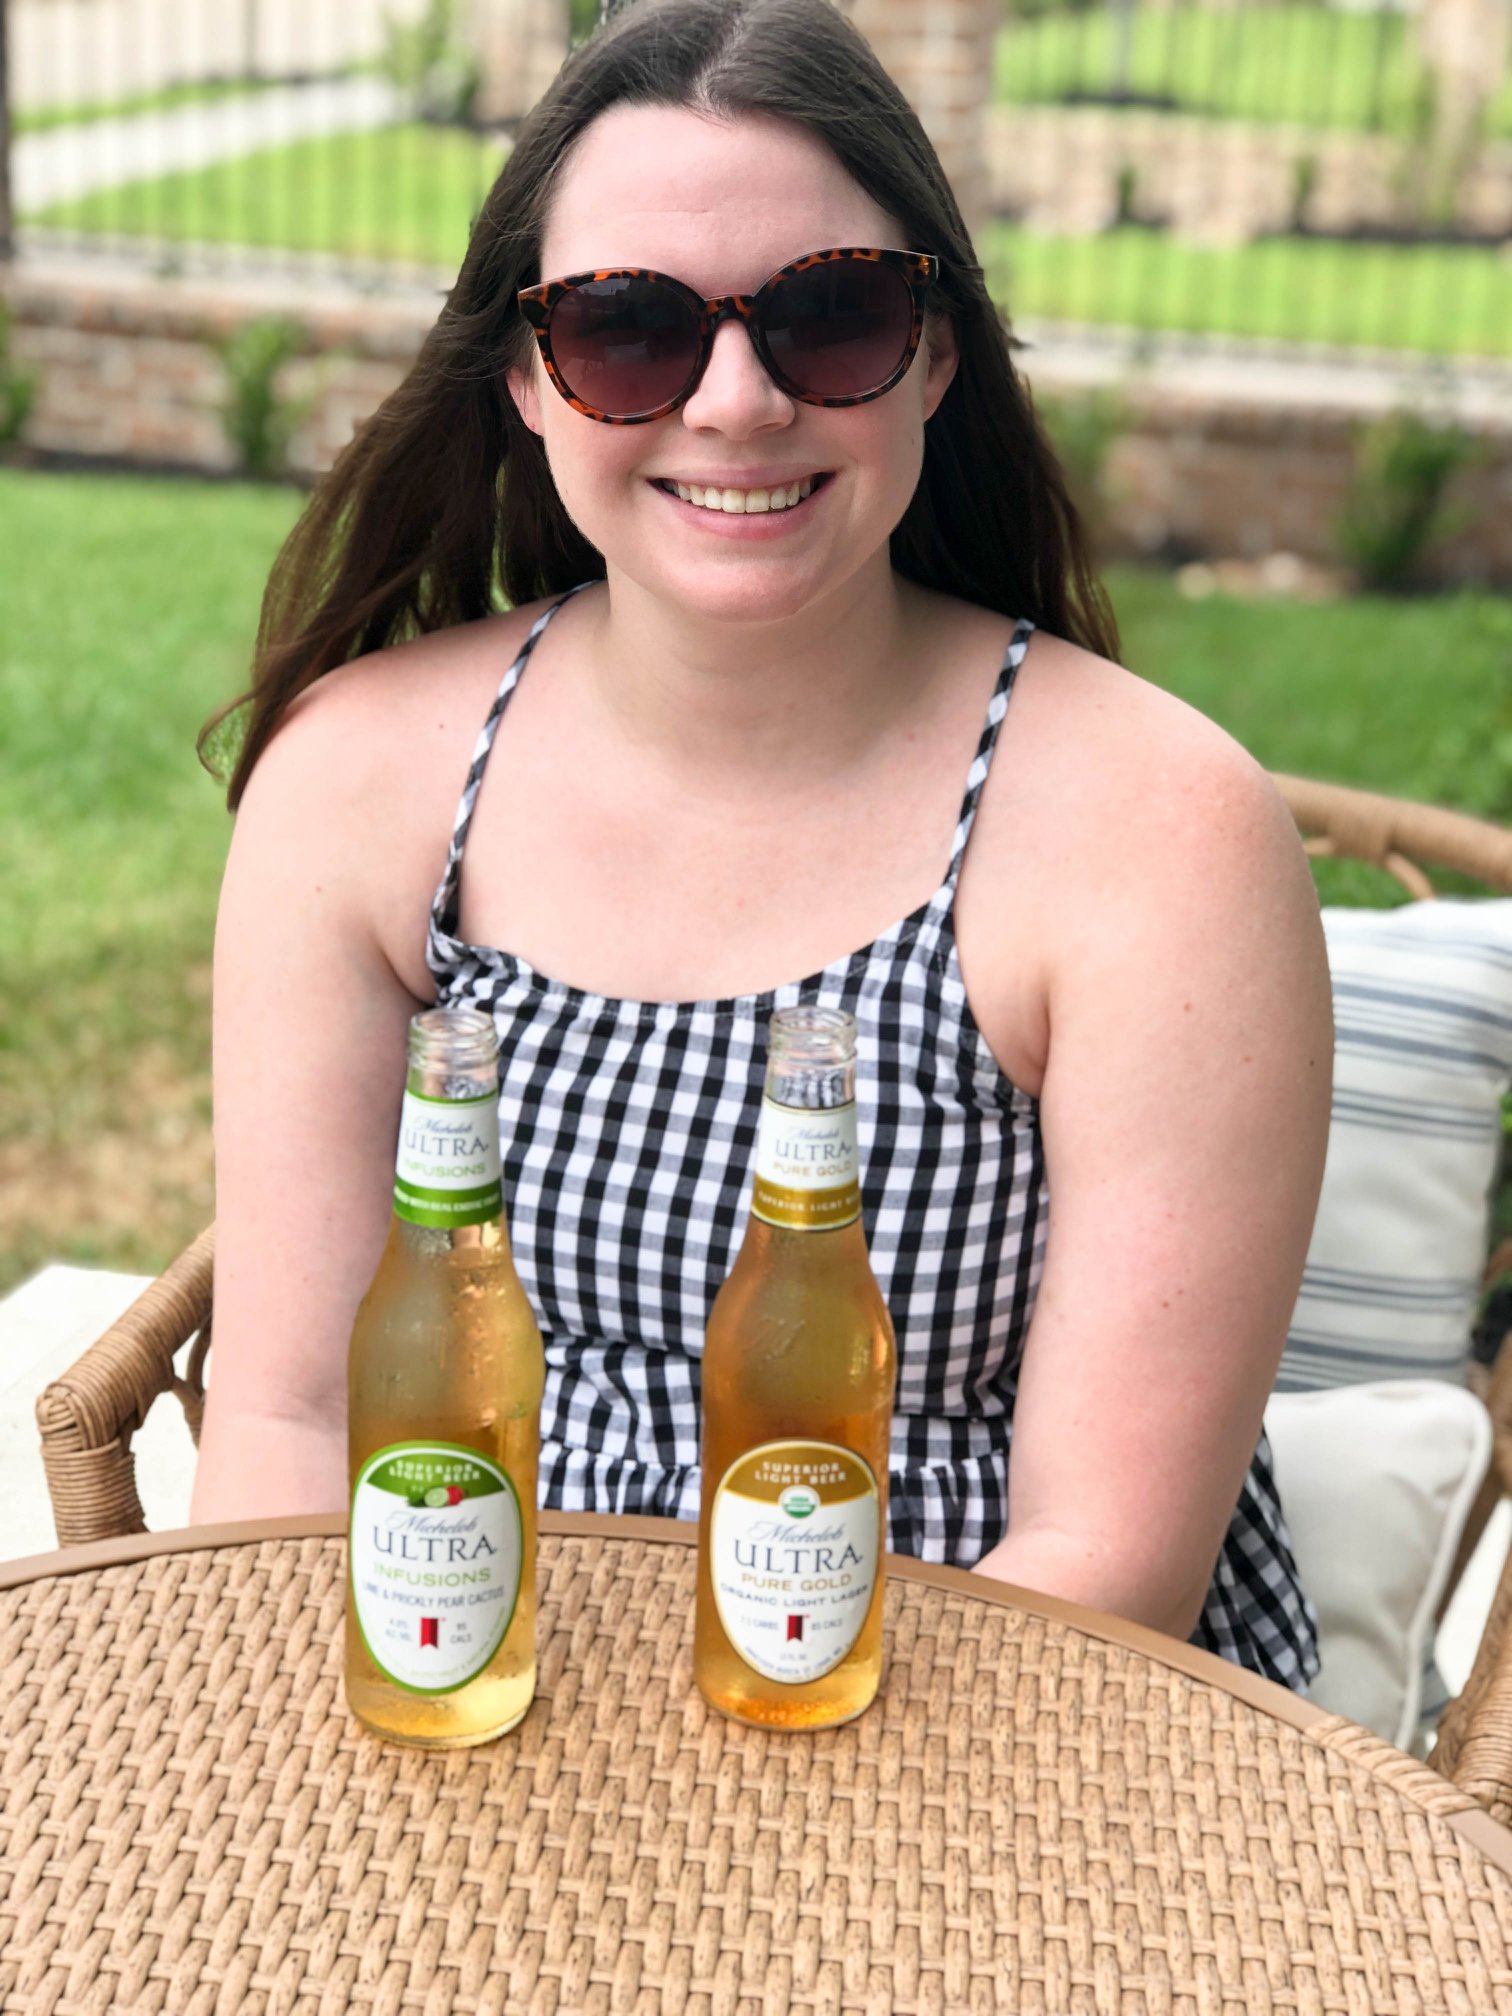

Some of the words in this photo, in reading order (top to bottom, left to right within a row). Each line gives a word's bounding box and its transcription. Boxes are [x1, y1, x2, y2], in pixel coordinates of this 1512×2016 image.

[405, 1127, 489, 1157] ULTRA
[775, 1140, 852, 1161] ULTRA
[773, 1161, 810, 1177] PURE
[816, 1161, 852, 1177] GOLD
[388, 1466, 433, 1482] LIGHT
[443, 1470, 480, 1483] BEER
[396, 1459, 474, 1475] SUPERIOR
[762, 1462, 840, 1475] SUPERIOR
[755, 1471, 801, 1484] LIGHT
[809, 1472, 846, 1485] BEER
[386, 1511, 479, 1535] Michelob
[748, 1520, 845, 1544] Michelob
[373, 1525, 498, 1562] ULTRA
[735, 1539, 864, 1574] ULTRA
[373, 1562, 492, 1588] INFUSIONS
[741, 1573, 792, 1591] PURE
[801, 1574, 852, 1592] GOLD
[437, 1595, 466, 1609] PEAR
[721, 1582, 778, 1606] ORGANIC
[783, 1597, 826, 1608] LIGHT
